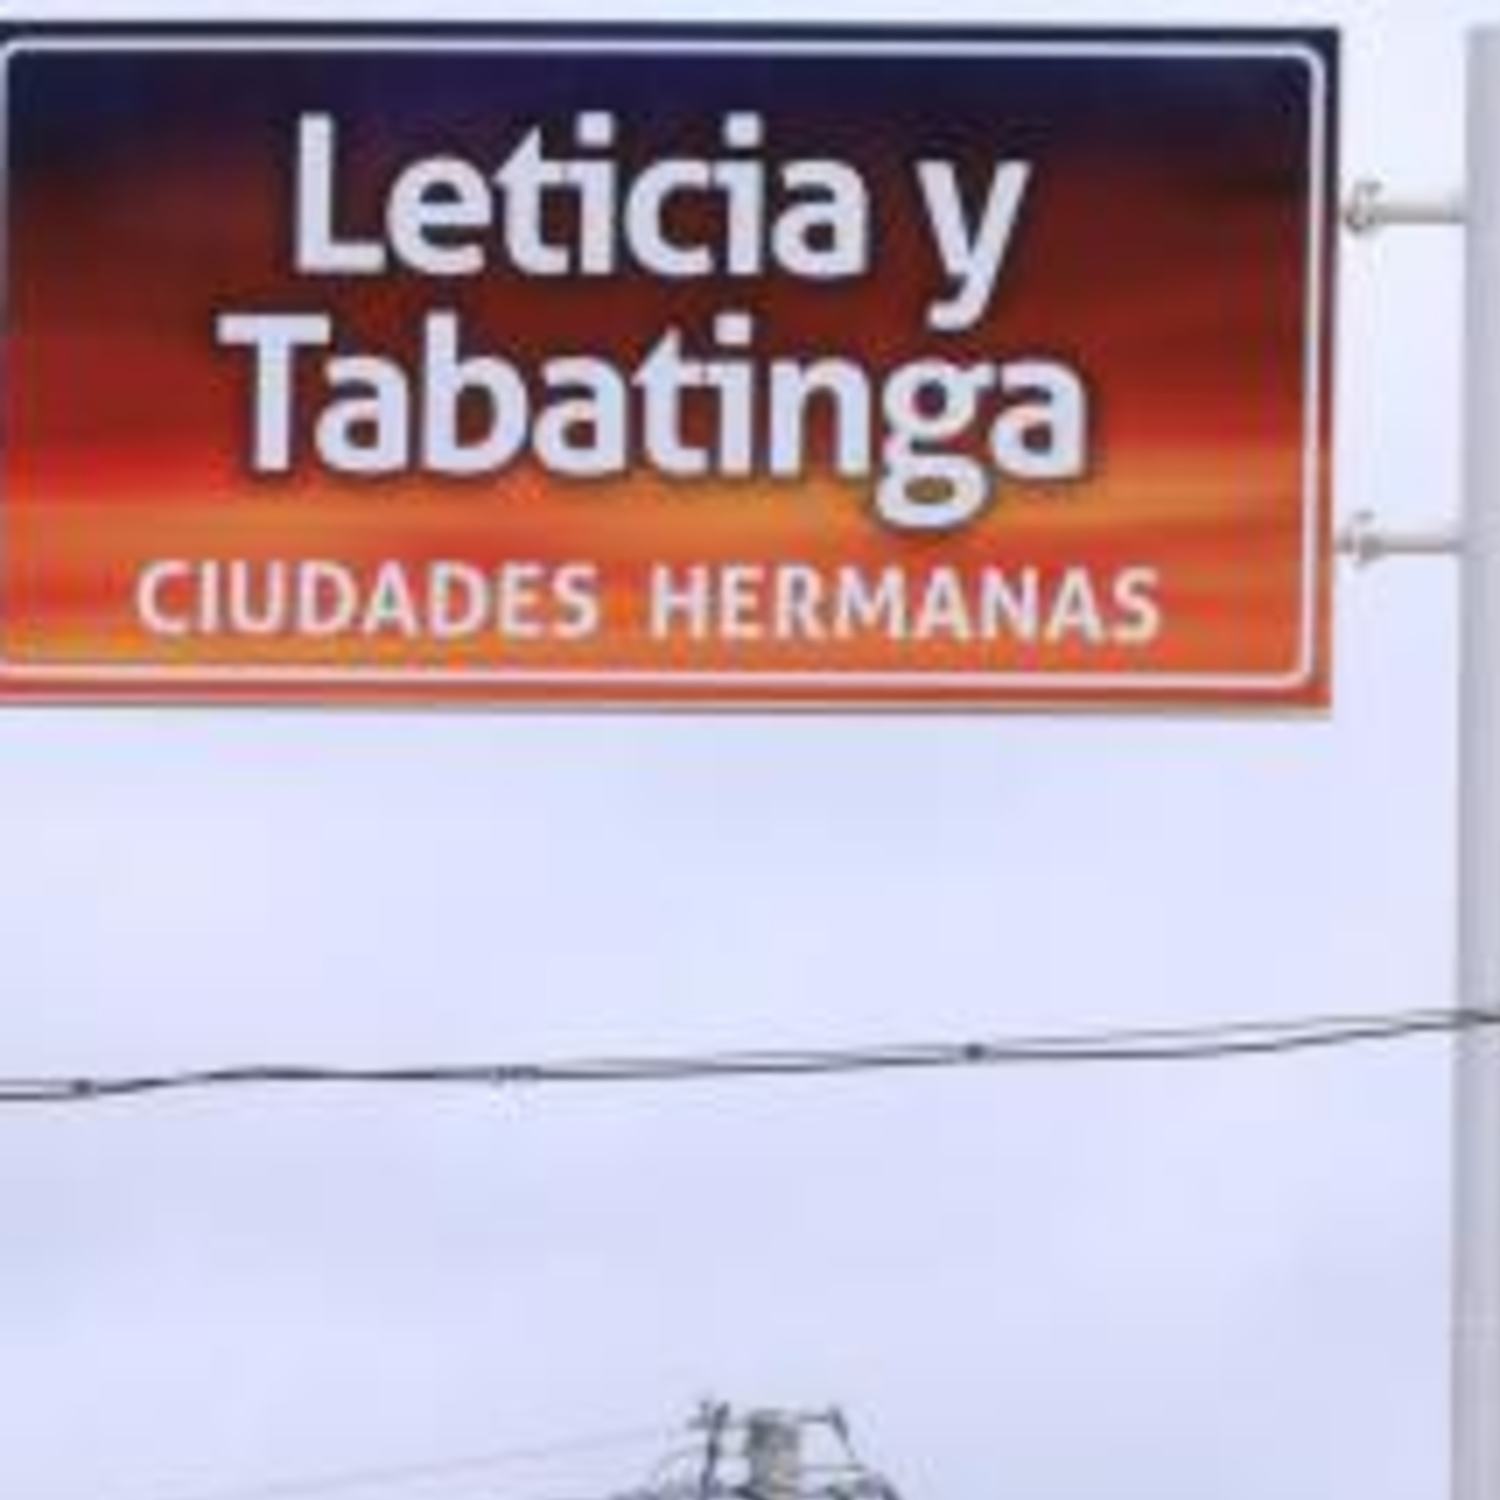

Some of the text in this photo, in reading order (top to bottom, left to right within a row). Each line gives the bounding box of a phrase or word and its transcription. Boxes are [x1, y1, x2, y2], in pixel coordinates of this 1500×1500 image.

[293, 110, 1029, 330] Leticia y
[216, 311, 1089, 530] Tabatinga
[136, 558, 1163, 645] CIUDADES HERMANAS
